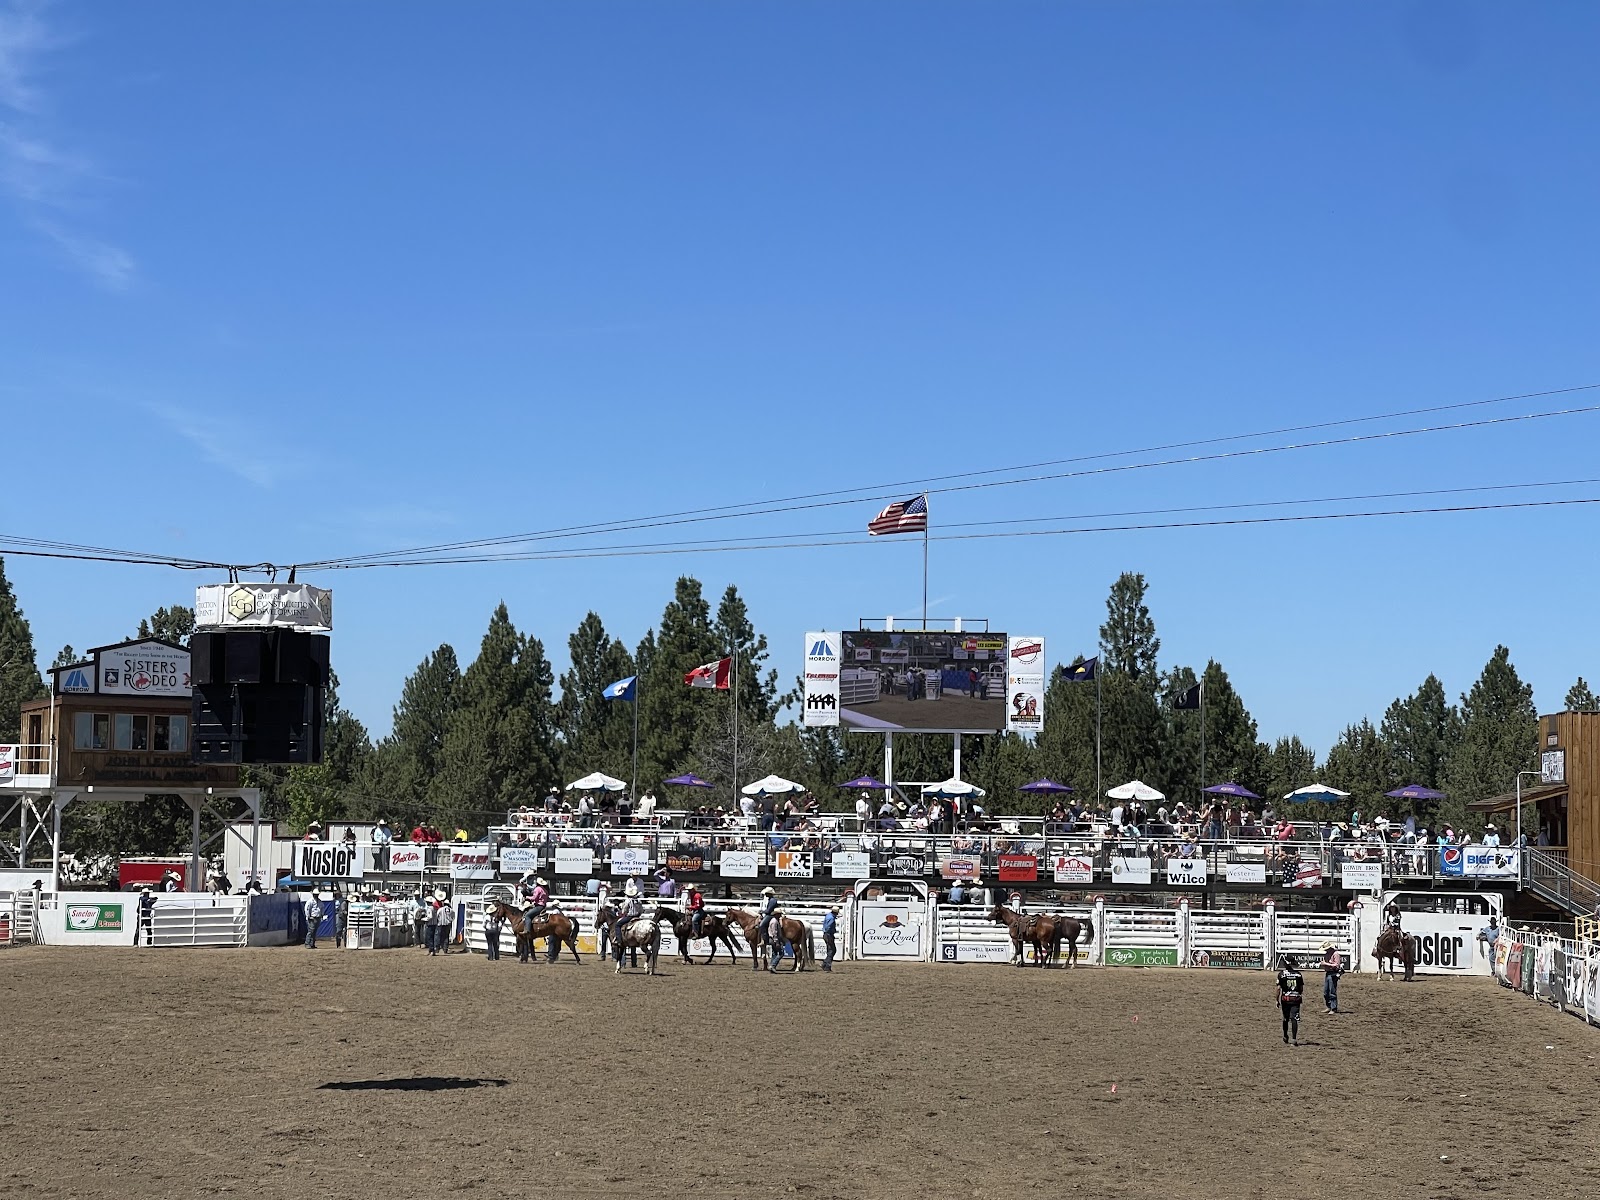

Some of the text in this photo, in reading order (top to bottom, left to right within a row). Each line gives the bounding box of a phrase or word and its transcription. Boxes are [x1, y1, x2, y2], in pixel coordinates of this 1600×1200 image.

[108, 756, 140, 766] JOHN
[95, 770, 207, 781] MEMORIAL ARENA
[392, 852, 421, 866] Baxter
[503, 849, 536, 859] KEVIN SPENCER
[301, 846, 357, 875] Nosler
[778, 853, 811, 869] H&E
[1000, 859, 1035, 868] TALERICO
[1168, 873, 1206, 884] Wilco
[71, 909, 97, 918] Sinclair
[863, 929, 920, 946] Crown Royal
[1412, 932, 1463, 967] osler
[1111, 951, 1134, 963] Ray's
[1143, 956, 1170, 965] LOCAL
